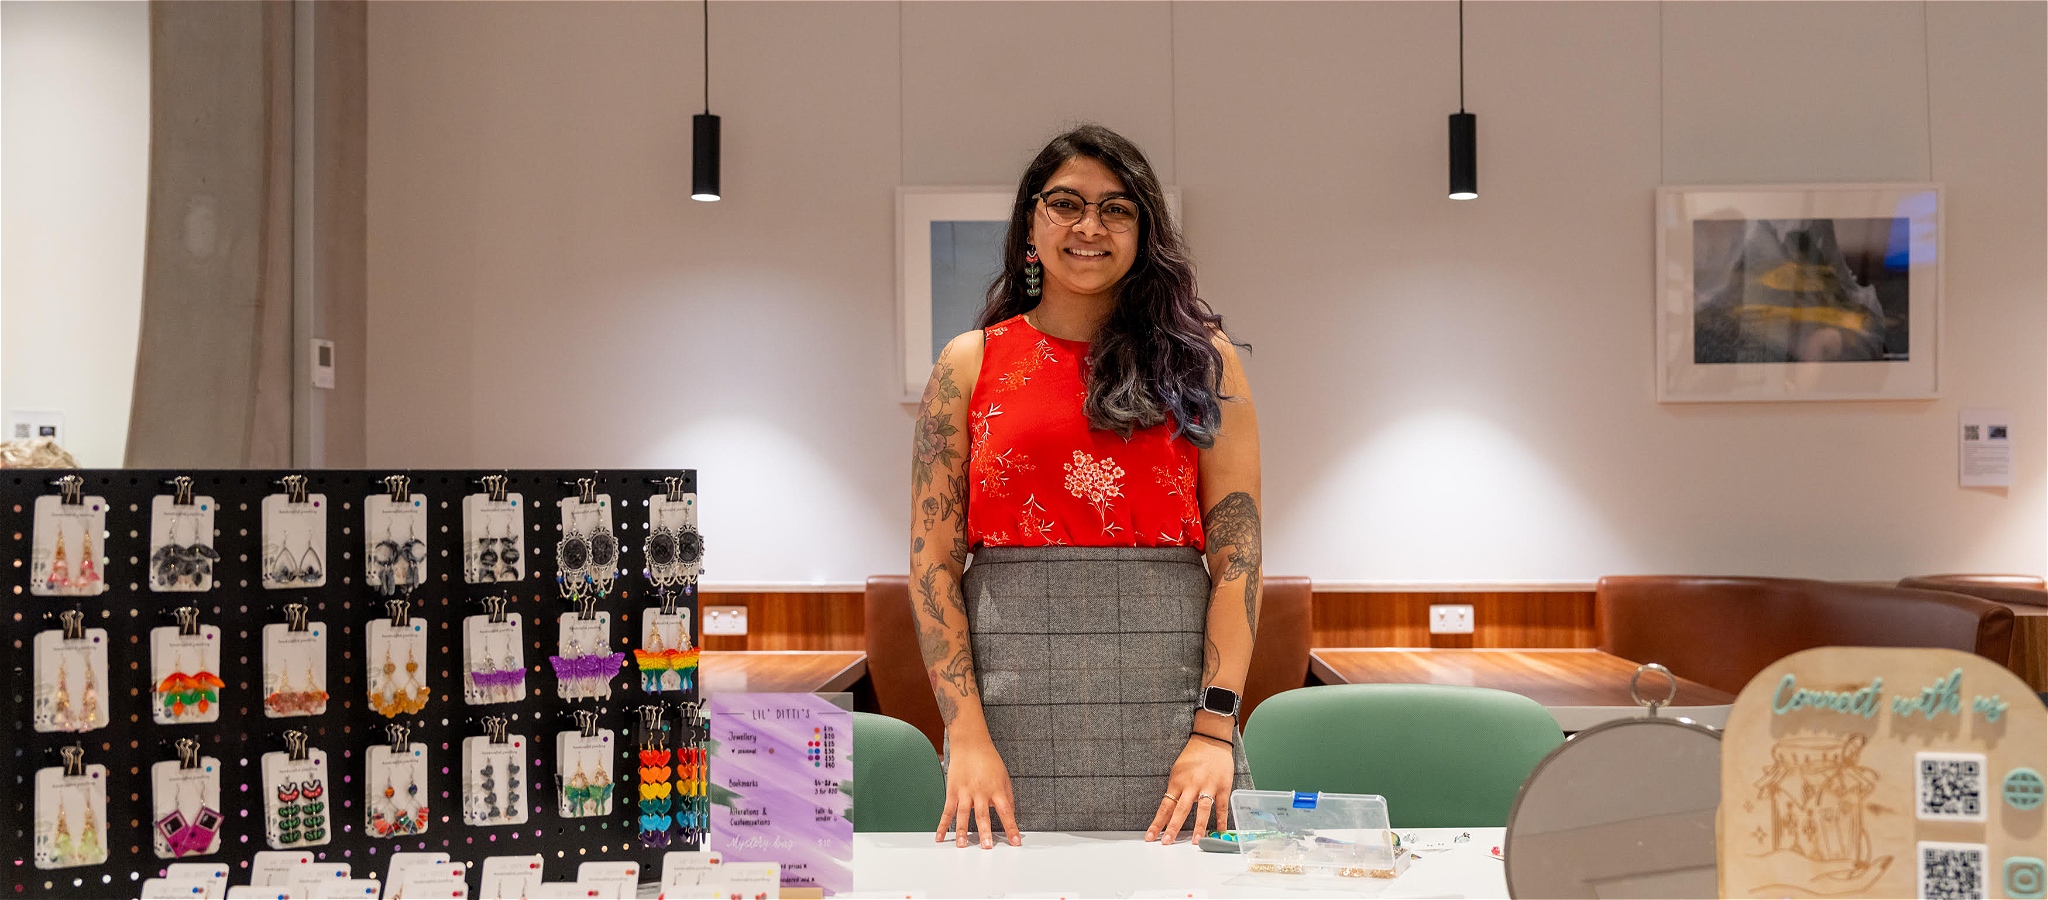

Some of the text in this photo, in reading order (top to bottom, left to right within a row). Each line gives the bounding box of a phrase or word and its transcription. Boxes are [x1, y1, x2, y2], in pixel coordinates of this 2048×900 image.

[1773, 667, 2009, 722] Connect with us
[728, 731, 757, 743] Jewellery
[728, 779, 759, 787] Bookmarks
[730, 807, 759, 816] Alterations
[726, 834, 769, 853] Mystery
